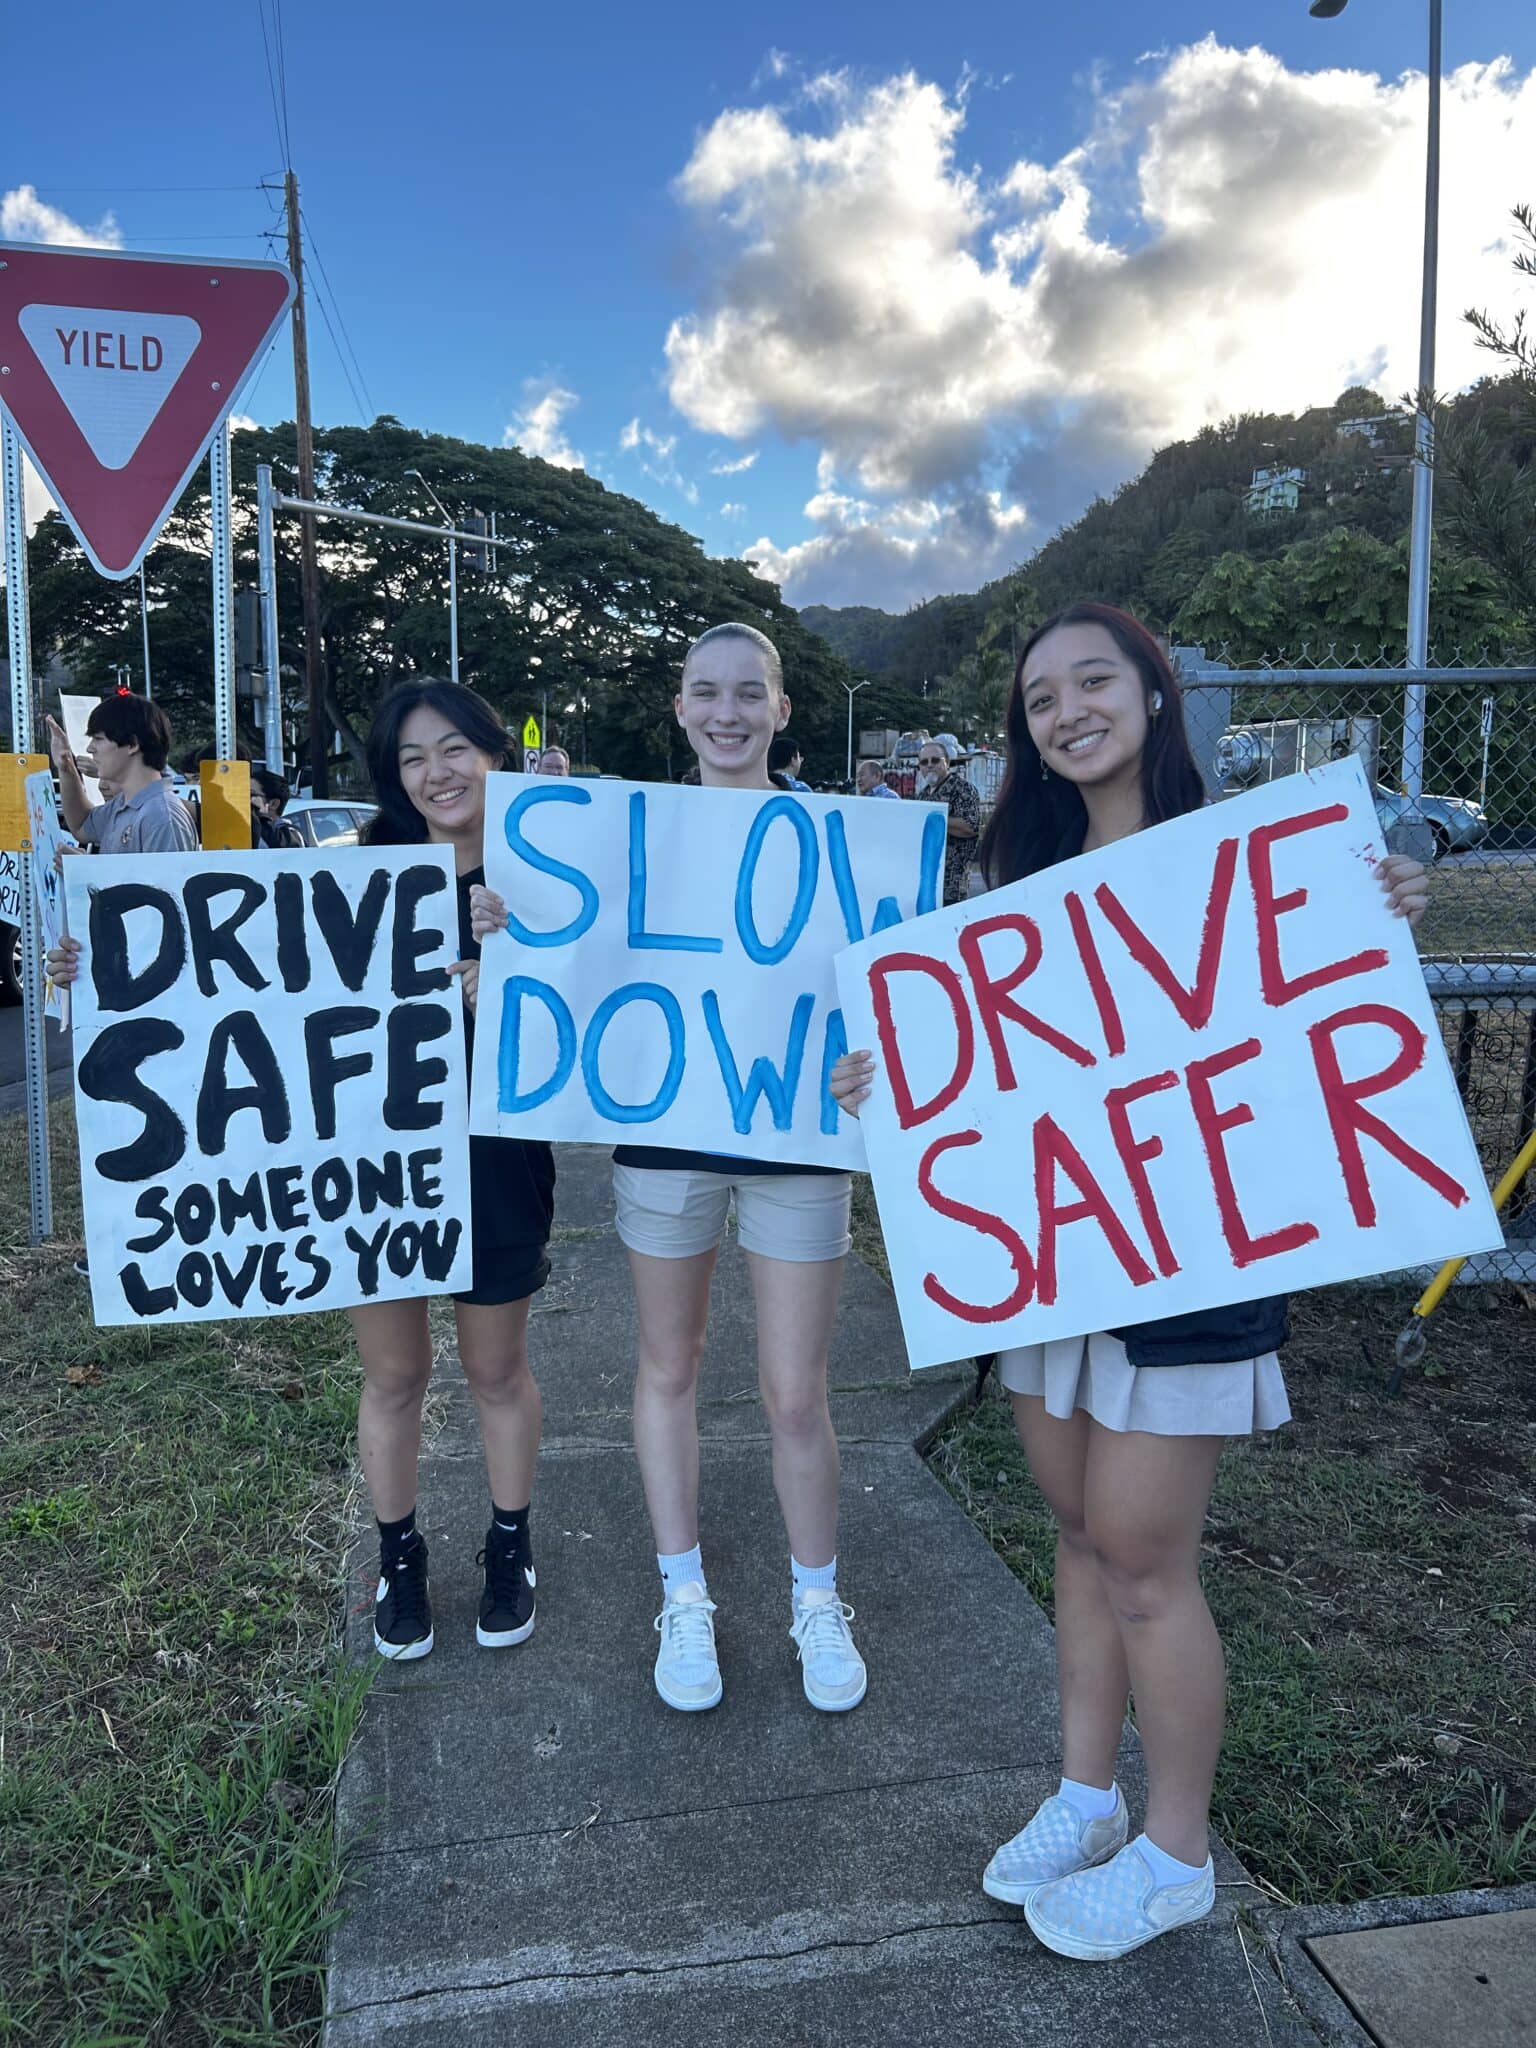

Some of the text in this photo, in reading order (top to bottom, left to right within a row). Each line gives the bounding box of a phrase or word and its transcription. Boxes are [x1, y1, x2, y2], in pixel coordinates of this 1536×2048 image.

[56, 329, 163, 372] YIELD
[88, 864, 453, 1012] DRIVE
[503, 784, 945, 966] SLOW
[868, 805, 1389, 1129] DRIVE
[78, 1003, 452, 1182] SAFE
[918, 1004, 1469, 1323] SAFER
[119, 1218, 463, 1316] LOVES YOU
[127, 1148, 444, 1253] SOMEONE
